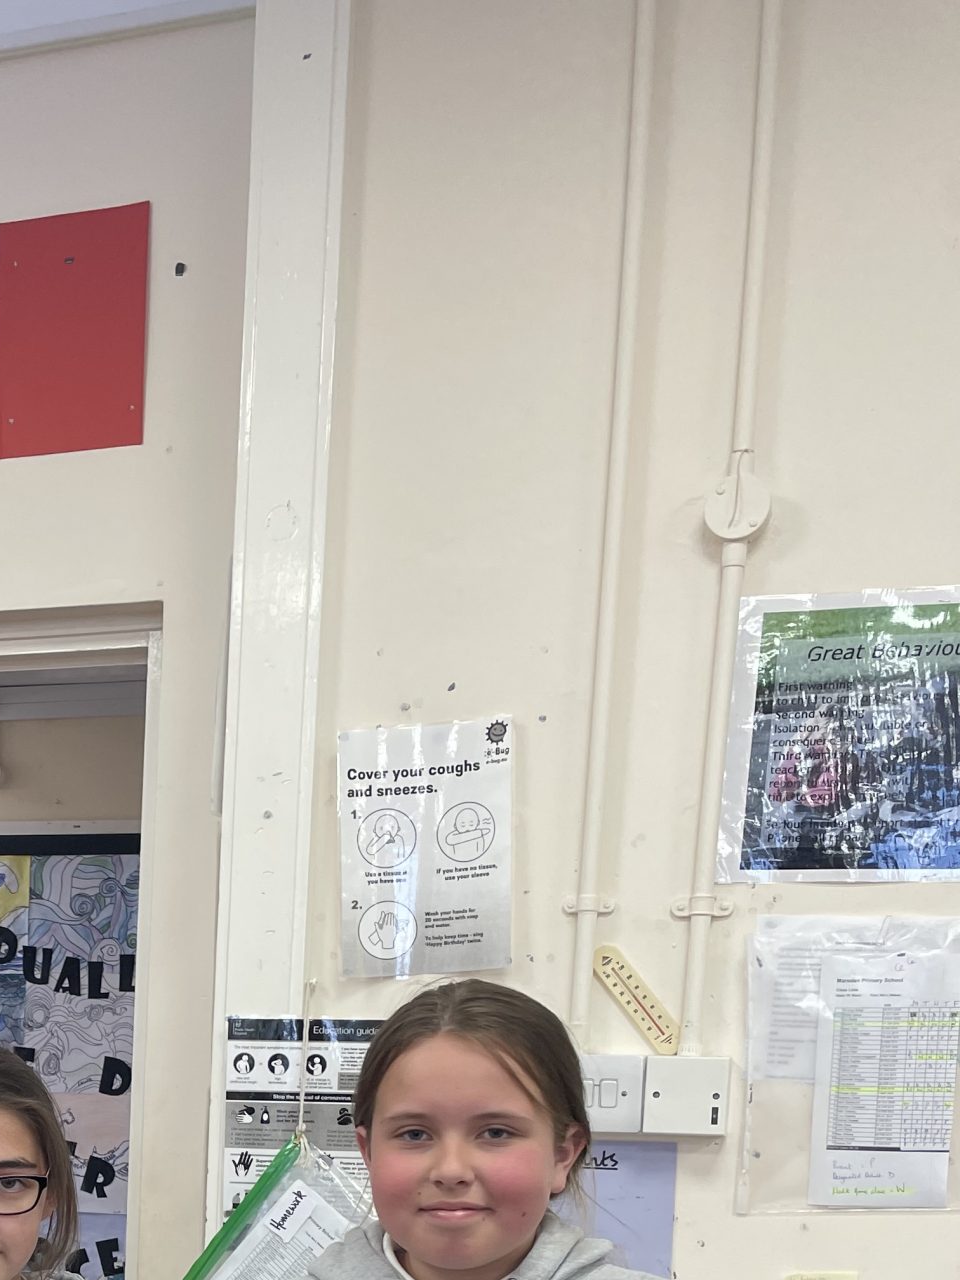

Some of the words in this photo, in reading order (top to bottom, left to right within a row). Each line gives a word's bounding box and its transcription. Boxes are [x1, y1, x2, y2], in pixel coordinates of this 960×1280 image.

[807, 644, 863, 662] Great
[778, 682, 804, 691] First
[808, 681, 853, 691] warning
[821, 696, 833, 704] to
[776, 710, 815, 719] Second
[774, 724, 820, 733] Isolation
[347, 768, 389, 780] Cover
[392, 767, 425, 782] your
[428, 760, 481, 777] coughs
[347, 785, 373, 798] and
[376, 783, 438, 797] sneezes.
[351, 900, 363, 910] 2.
[269, 1189, 307, 1231] Homework
